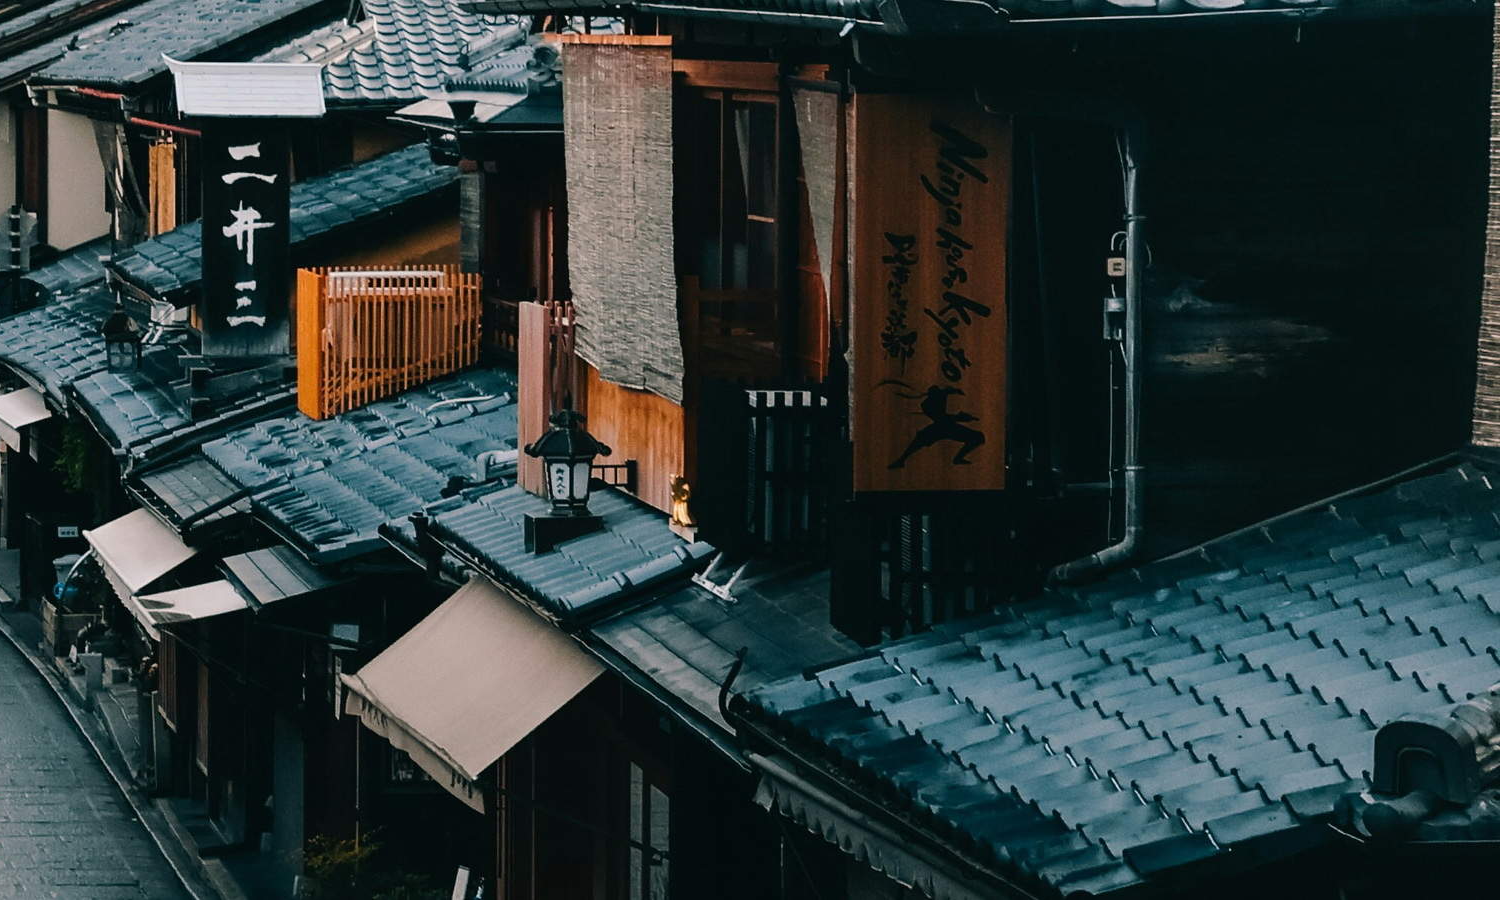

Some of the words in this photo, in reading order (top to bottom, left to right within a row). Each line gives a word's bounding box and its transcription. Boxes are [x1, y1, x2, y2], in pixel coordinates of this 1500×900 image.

[221, 142, 278, 327] 二井三
[920, 120, 989, 226] Ninja
